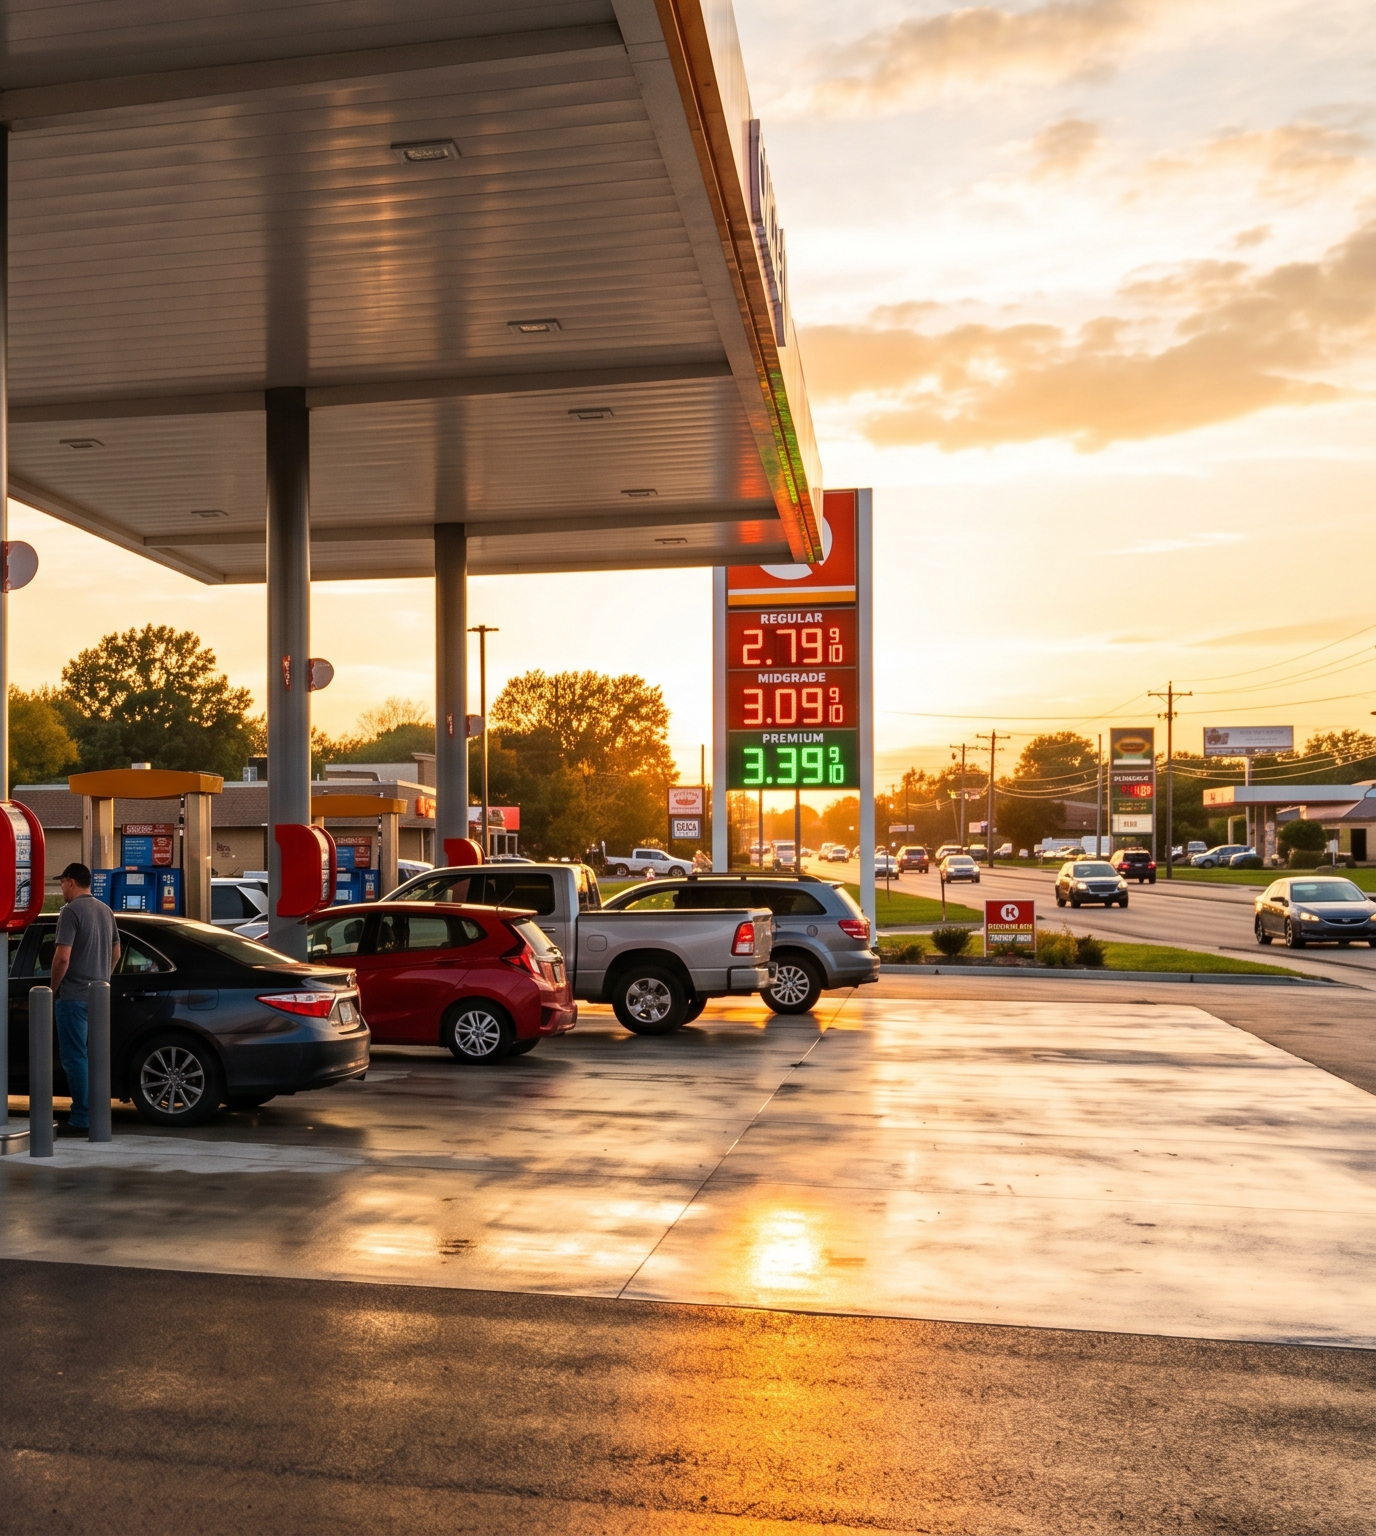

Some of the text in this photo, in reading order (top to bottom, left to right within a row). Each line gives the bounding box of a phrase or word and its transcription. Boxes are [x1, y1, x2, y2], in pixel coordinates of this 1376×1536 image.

[760, 613, 823, 624] REGULAR
[742, 628, 843, 665] 2.79 9 10
[758, 673, 826, 683] MIDGRADE
[743, 688, 843, 724] 3.09 9 10
[762, 733, 824, 744] PREMIUM
[743, 747, 844, 784] 3.39 9 10
